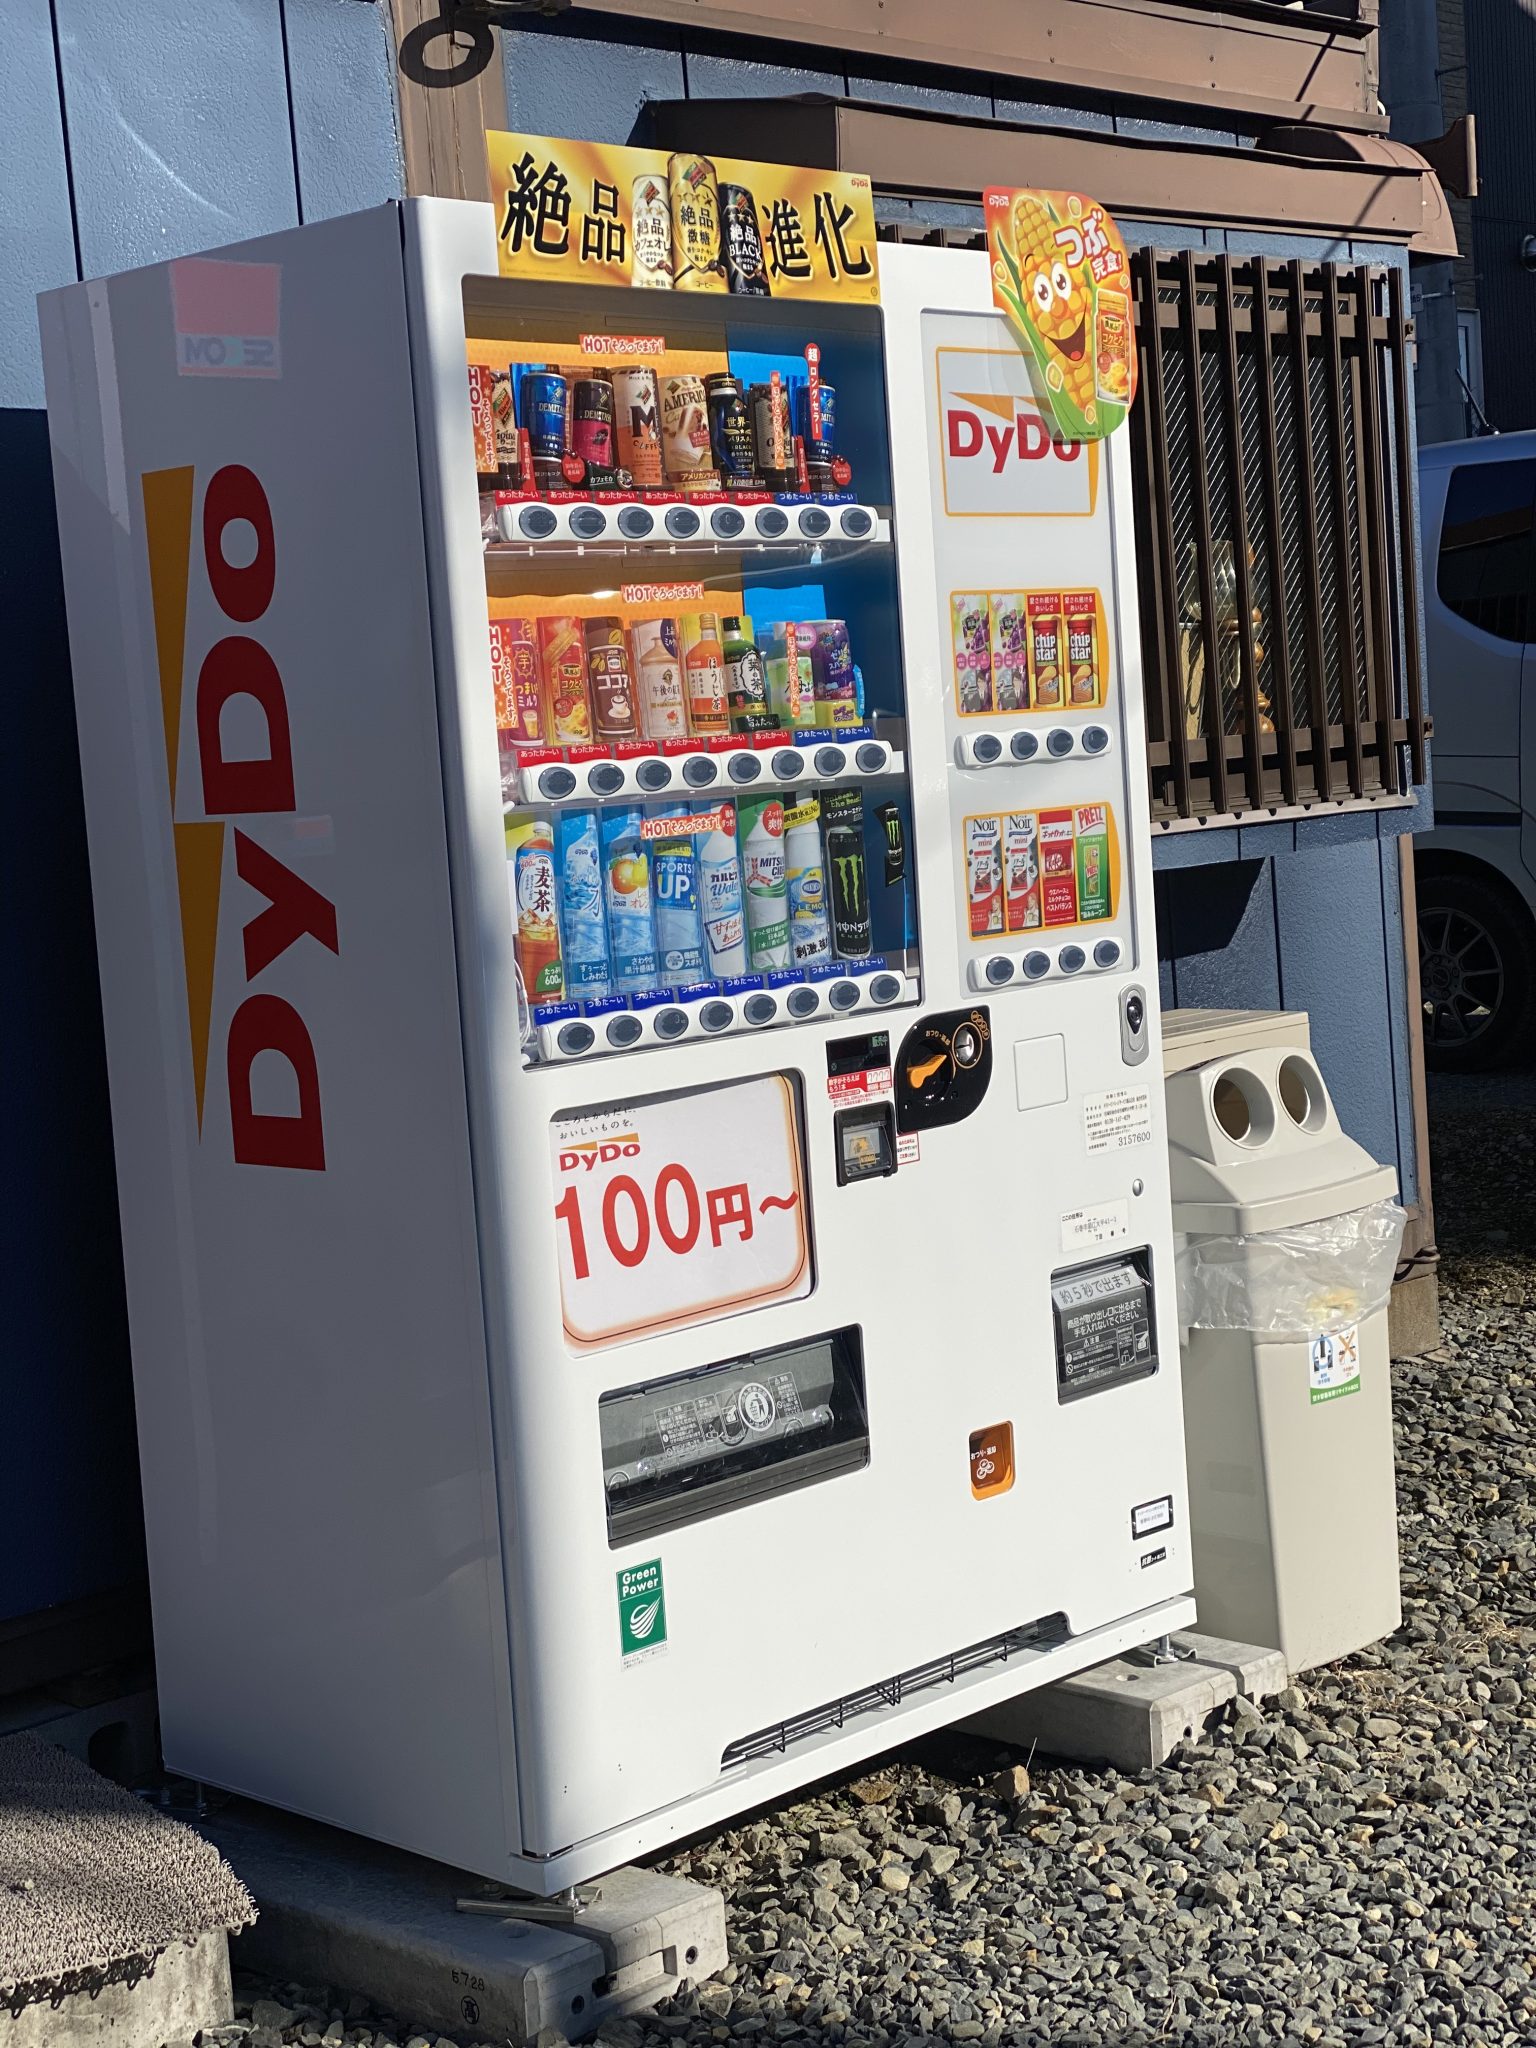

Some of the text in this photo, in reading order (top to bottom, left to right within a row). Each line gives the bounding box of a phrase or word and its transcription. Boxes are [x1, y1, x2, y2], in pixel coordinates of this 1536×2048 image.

[501, 151, 871, 278] 絶品 進化
[681, 206, 713, 230] 絶品
[637, 218, 664, 237] 絶品
[730, 224, 757, 244] 絶品
[1055, 207, 1109, 267] つぶ
[688, 229, 711, 246] 微糖
[729, 243, 761, 260] BLACK
[947, 409, 1082, 474] DyDo
[1035, 632, 1056, 650] chip
[1070, 631, 1091, 649] chip
[1035, 646, 1056, 661] star
[1070, 645, 1091, 660] star
[196, 463, 340, 1172] DyDo
[972, 819, 997, 832] Noir
[1008, 815, 1033, 831] Noir
[978, 838, 992, 847] mini
[1014, 836, 1028, 845] mini
[534, 867, 550, 912] 麦茶
[657, 874, 690, 899] UP
[1118, 1131, 1151, 1147] 3157600
[559, 1143, 641, 1171] DyDo
[1059, 1271, 1131, 1304] 約5秒で出ます
[1067, 1298, 1142, 1330] 商品が取り出し口に出るまで
[622, 1567, 656, 1585] Green
[622, 1578, 658, 1597] Power
